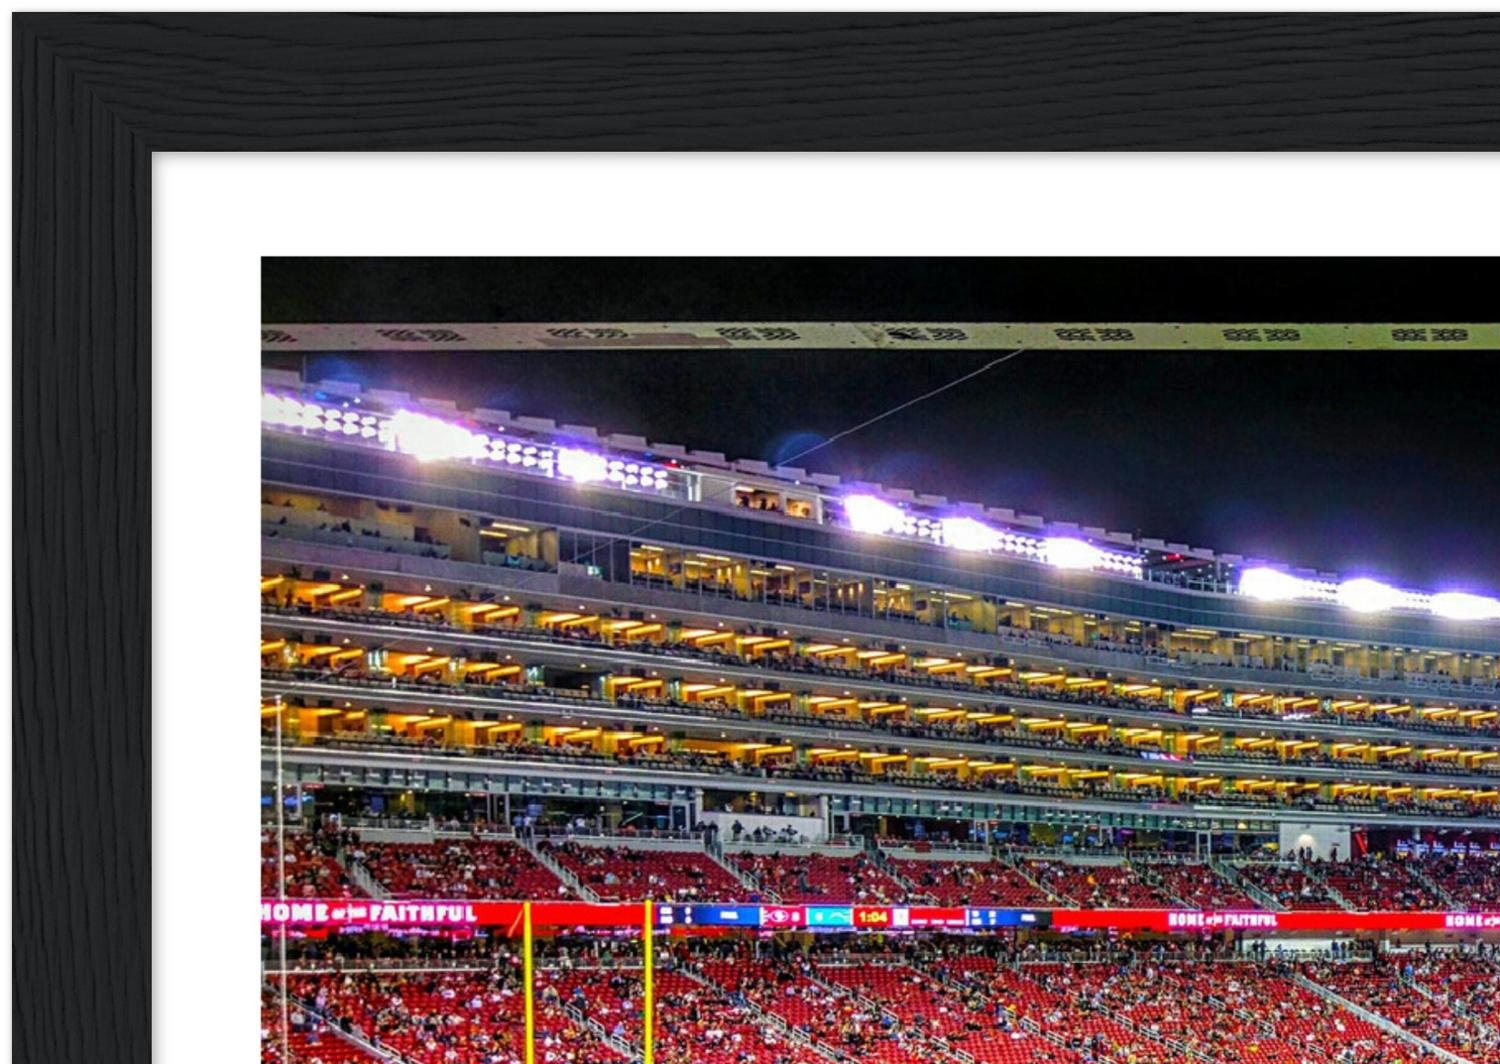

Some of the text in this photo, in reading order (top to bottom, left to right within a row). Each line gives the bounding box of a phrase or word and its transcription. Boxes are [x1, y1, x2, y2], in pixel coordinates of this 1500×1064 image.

[370, 904, 477, 921] FAITHFUL
[858, 912, 888, 922] 1:04
[1168, 913, 1204, 926] HOME
[1225, 914, 1278, 926] FAITHFUL
[1445, 915, 1482, 927] HOME
